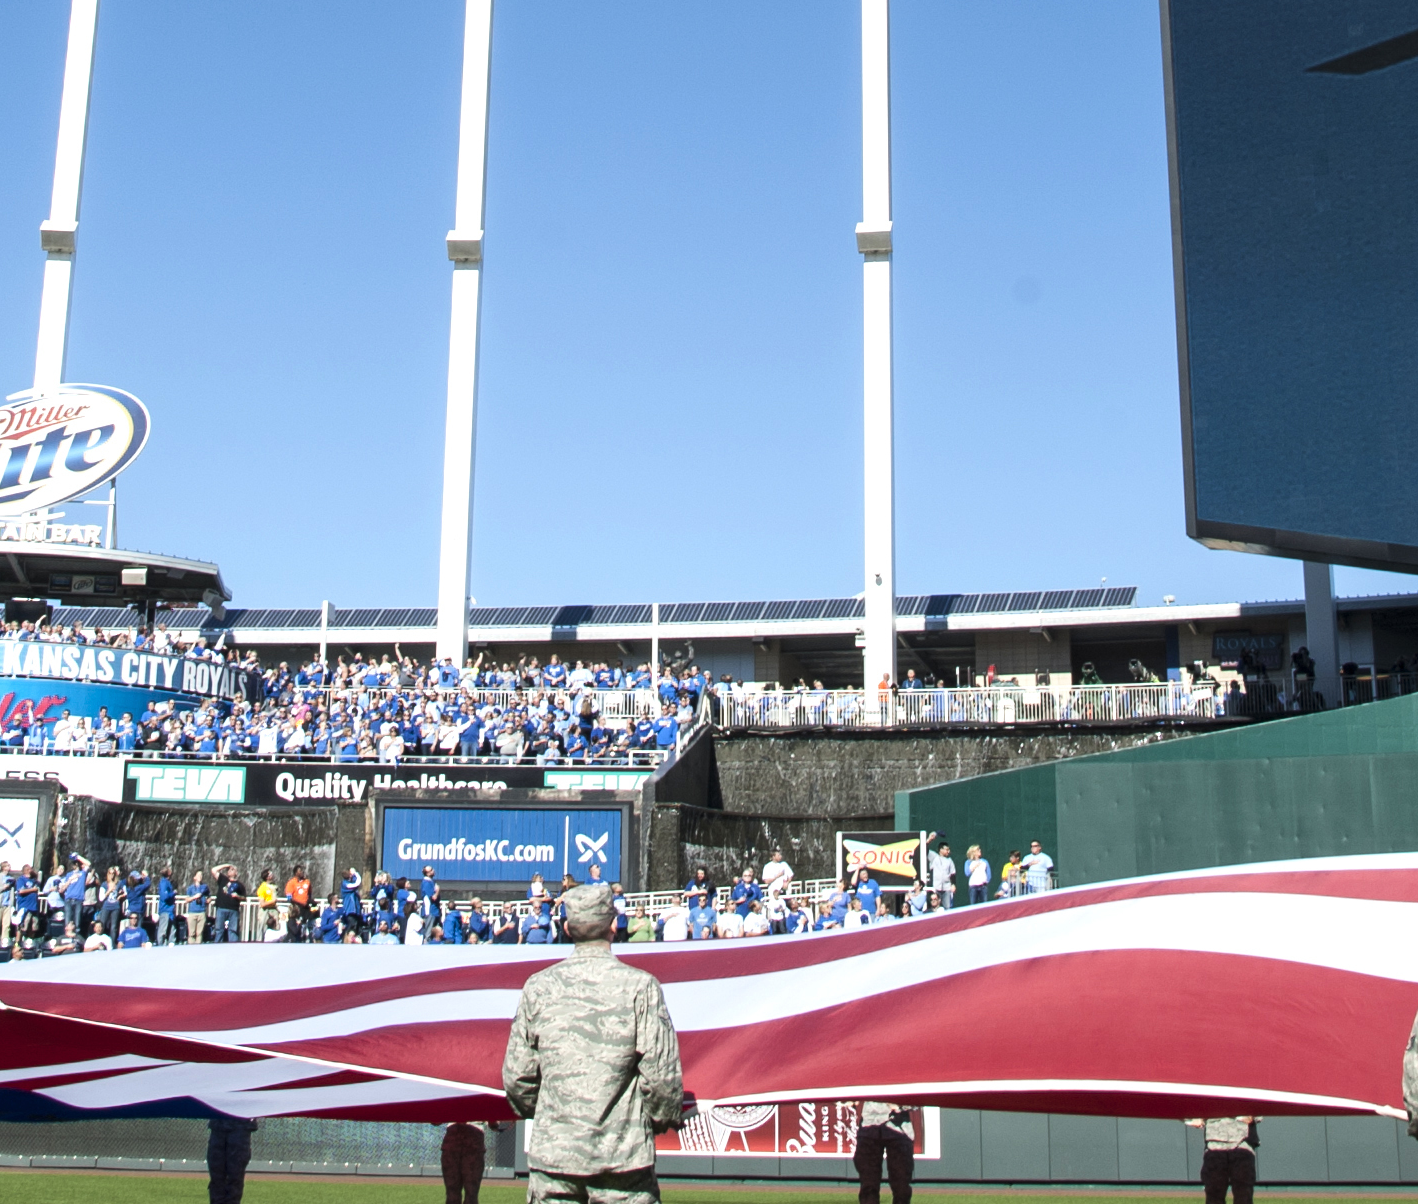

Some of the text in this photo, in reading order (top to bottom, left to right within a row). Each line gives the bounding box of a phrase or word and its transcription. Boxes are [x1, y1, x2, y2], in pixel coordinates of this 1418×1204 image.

[52, 524, 103, 544] BAR
[1216, 637, 1277, 650] ROYALS
[3, 641, 115, 682] KANSAS
[121, 652, 179, 689] CITY
[182, 661, 248, 701] ROYALS
[127, 766, 243, 801] TEVA
[275, 772, 367, 802] Quality
[398, 837, 555, 863] GrundfosKC.com
[851, 850, 913, 865] SONIC
[821, 1105, 830, 1142] KING
